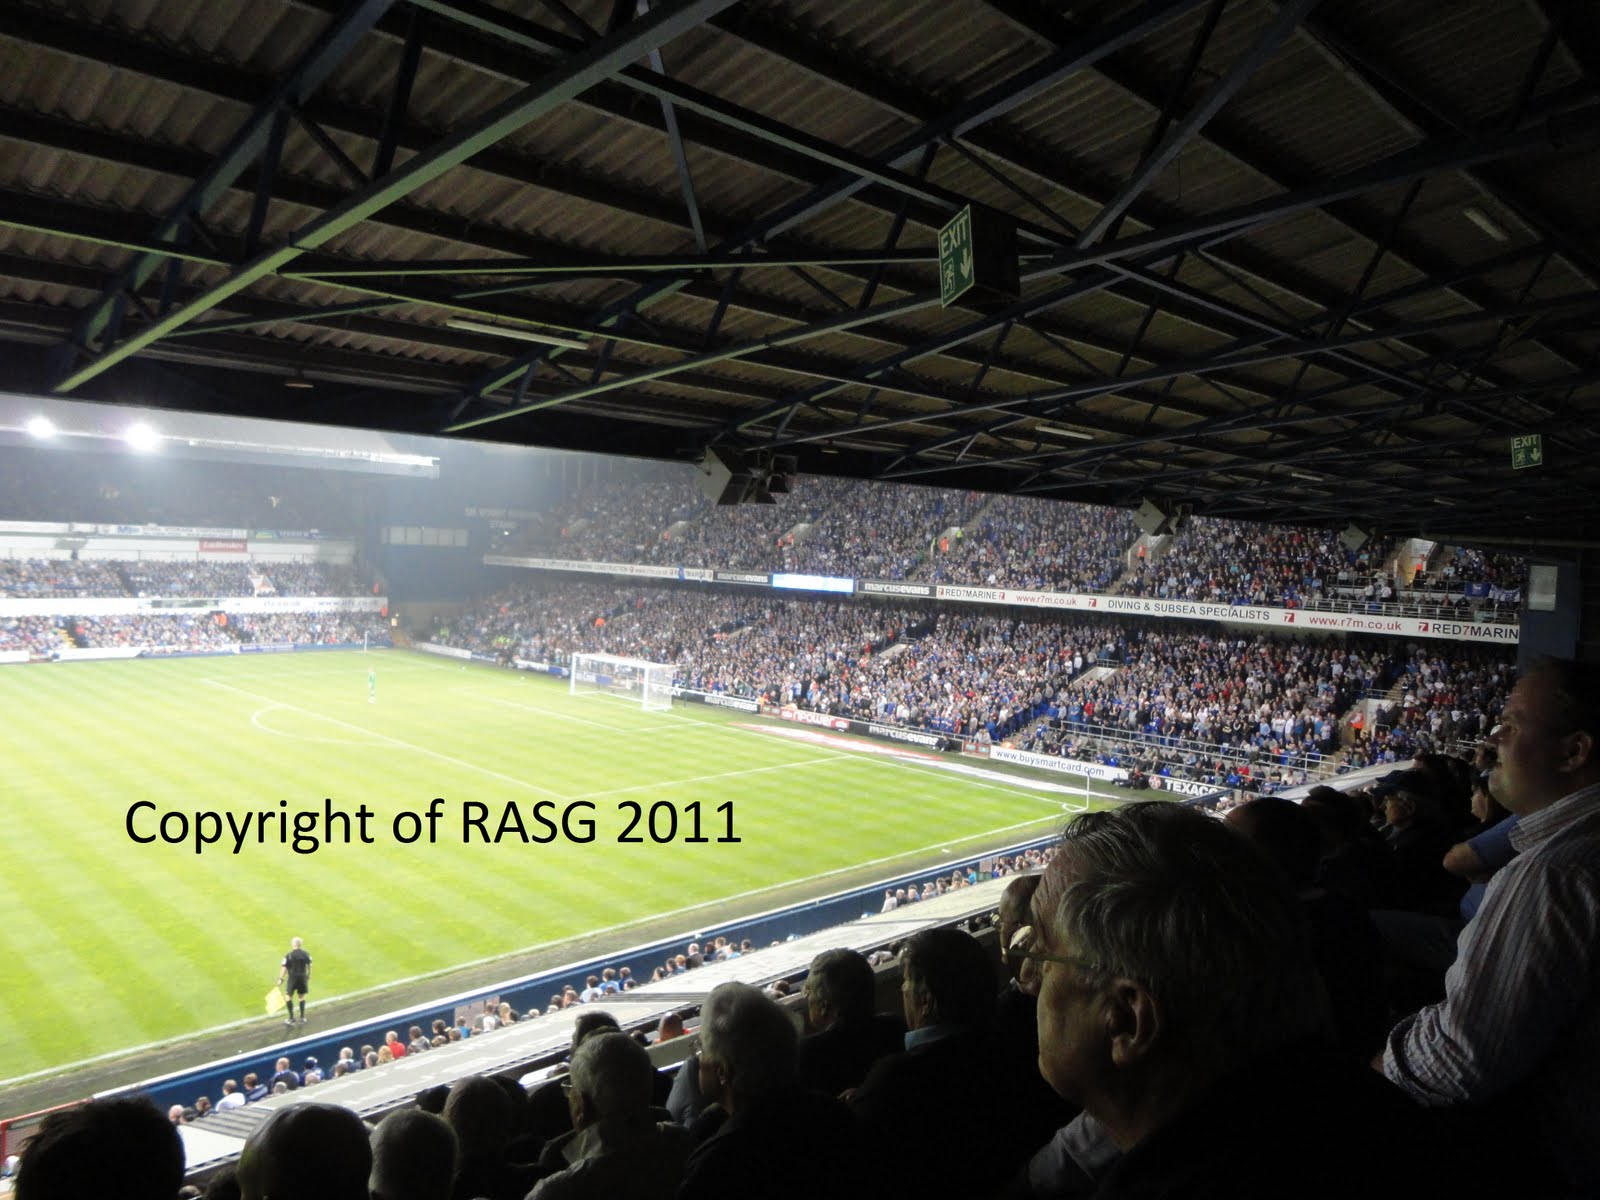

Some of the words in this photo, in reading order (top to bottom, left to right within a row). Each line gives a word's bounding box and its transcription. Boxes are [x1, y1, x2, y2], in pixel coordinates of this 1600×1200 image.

[940, 213, 969, 257] EXIT
[1513, 435, 1537, 448] EXIT
[717, 572, 769, 583] marcusevans
[864, 582, 930, 595] marcusevans
[945, 588, 997, 600] RED7MARINE
[1016, 594, 1077, 606] www.r7m.co.uk
[1108, 599, 1141, 610] DIVING
[1144, 603, 1151, 611] &
[1154, 603, 1196, 615] SUBSEA
[1199, 605, 1270, 620] SPECIALISTS
[1309, 615, 1402, 631] www.r7m.co.uk
[1432, 623, 1519, 640] RED7MARIN
[704, 695, 758, 712] marcusevans
[792, 709, 835, 728] npower
[869, 725, 938, 745] marcusevans
[996, 749, 1105, 776] www.buysmartcard.com
[1164, 779, 1218, 796] TEXACO
